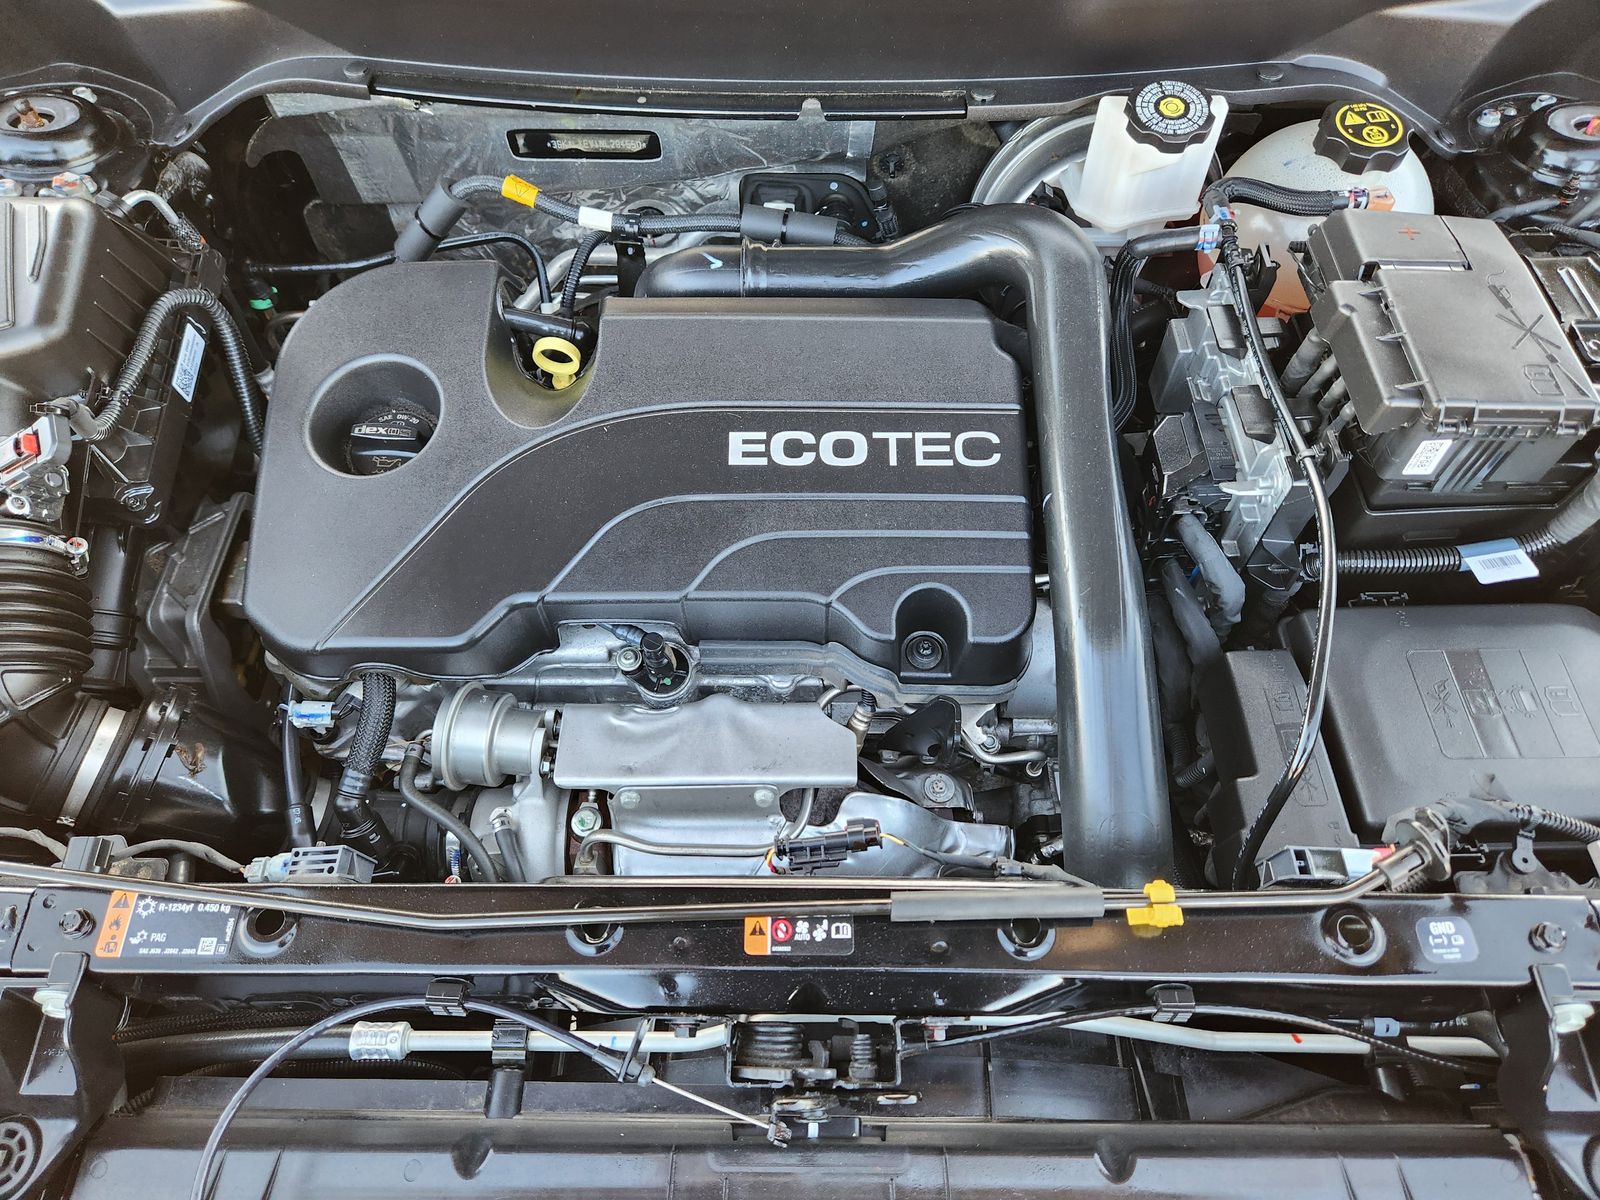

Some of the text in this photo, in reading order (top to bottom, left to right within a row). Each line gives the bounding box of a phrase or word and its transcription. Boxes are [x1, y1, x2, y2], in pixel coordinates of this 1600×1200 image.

[397, 414, 419, 424] 0W-20
[354, 424, 412, 437] dexos
[728, 430, 1002, 467] ECOTEC
[159, 903, 231, 914] R-1234yf 0.450 kg
[1429, 922, 1455, 934] GND
[150, 933, 166, 942] PAG
